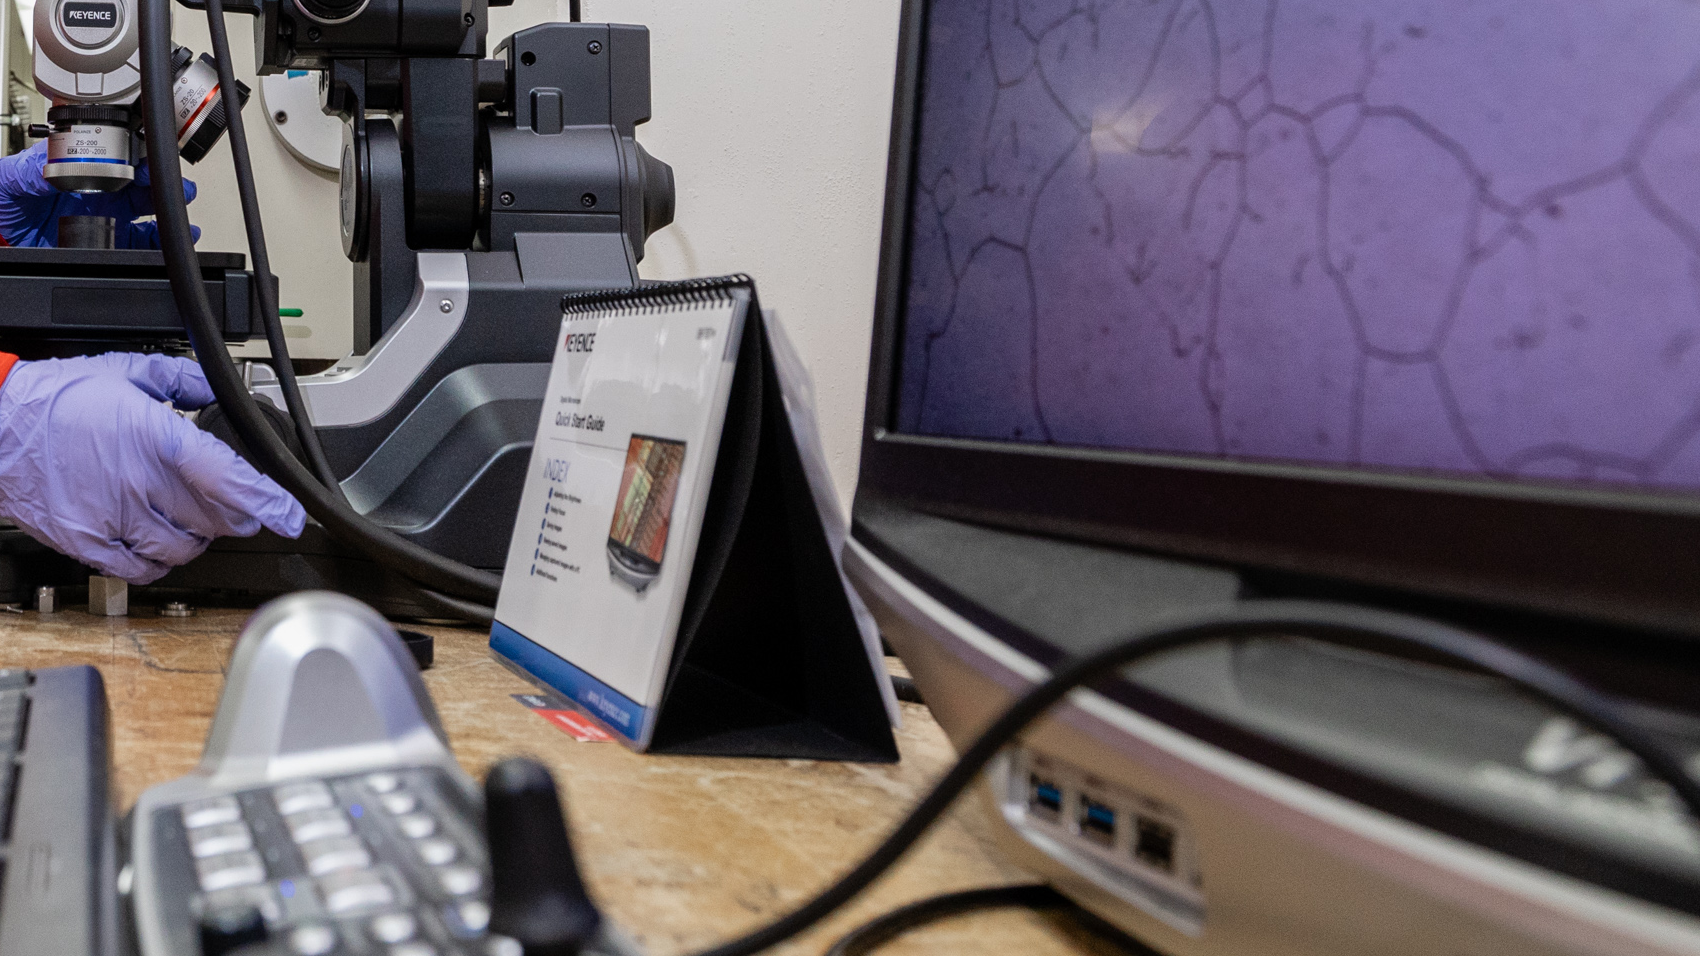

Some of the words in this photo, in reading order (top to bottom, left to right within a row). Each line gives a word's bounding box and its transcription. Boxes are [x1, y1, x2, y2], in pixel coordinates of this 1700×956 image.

[69, 10, 111, 20] KEYENCE
[564, 332, 596, 353] KEYENCE
[555, 411, 571, 427] Quick
[571, 412, 586, 430] Start
[586, 413, 605, 432] Guide
